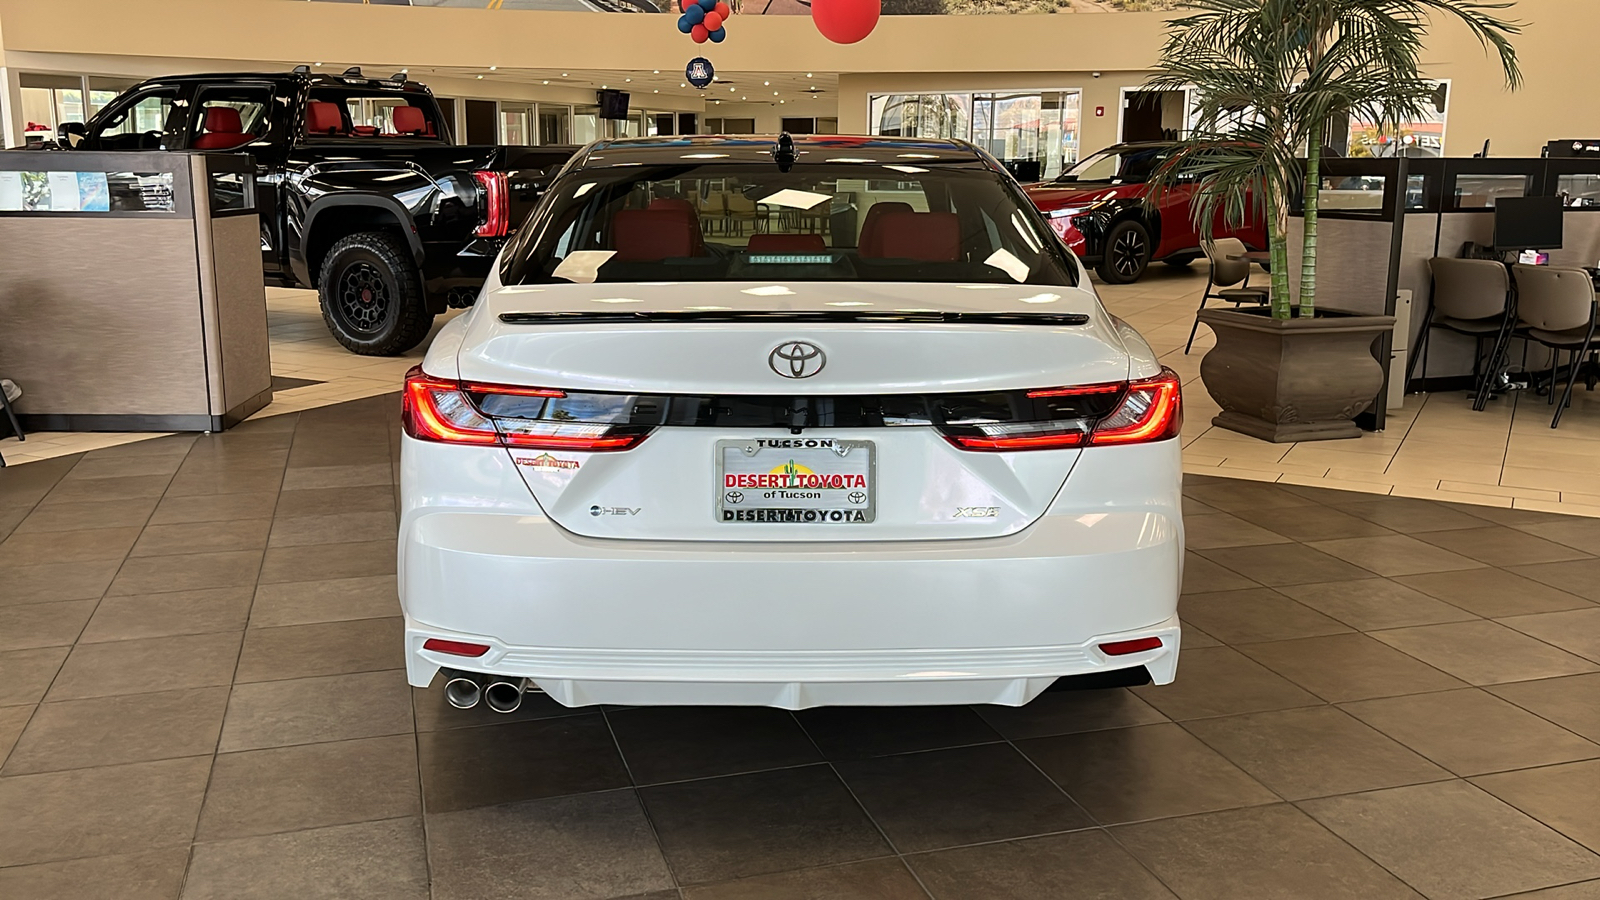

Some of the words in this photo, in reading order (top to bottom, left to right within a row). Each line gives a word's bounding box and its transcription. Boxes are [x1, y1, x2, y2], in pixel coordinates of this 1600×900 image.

[757, 439, 833, 448] TUCSON
[725, 474, 790, 488] DESERT
[798, 474, 867, 488] TOYOTA
[763, 490, 777, 499] of
[778, 490, 821, 499] Tucson
[602, 506, 641, 516] HEV
[723, 509, 788, 522] DESERT
[794, 509, 866, 522] TOYOTA
[953, 506, 1001, 518] XSE
